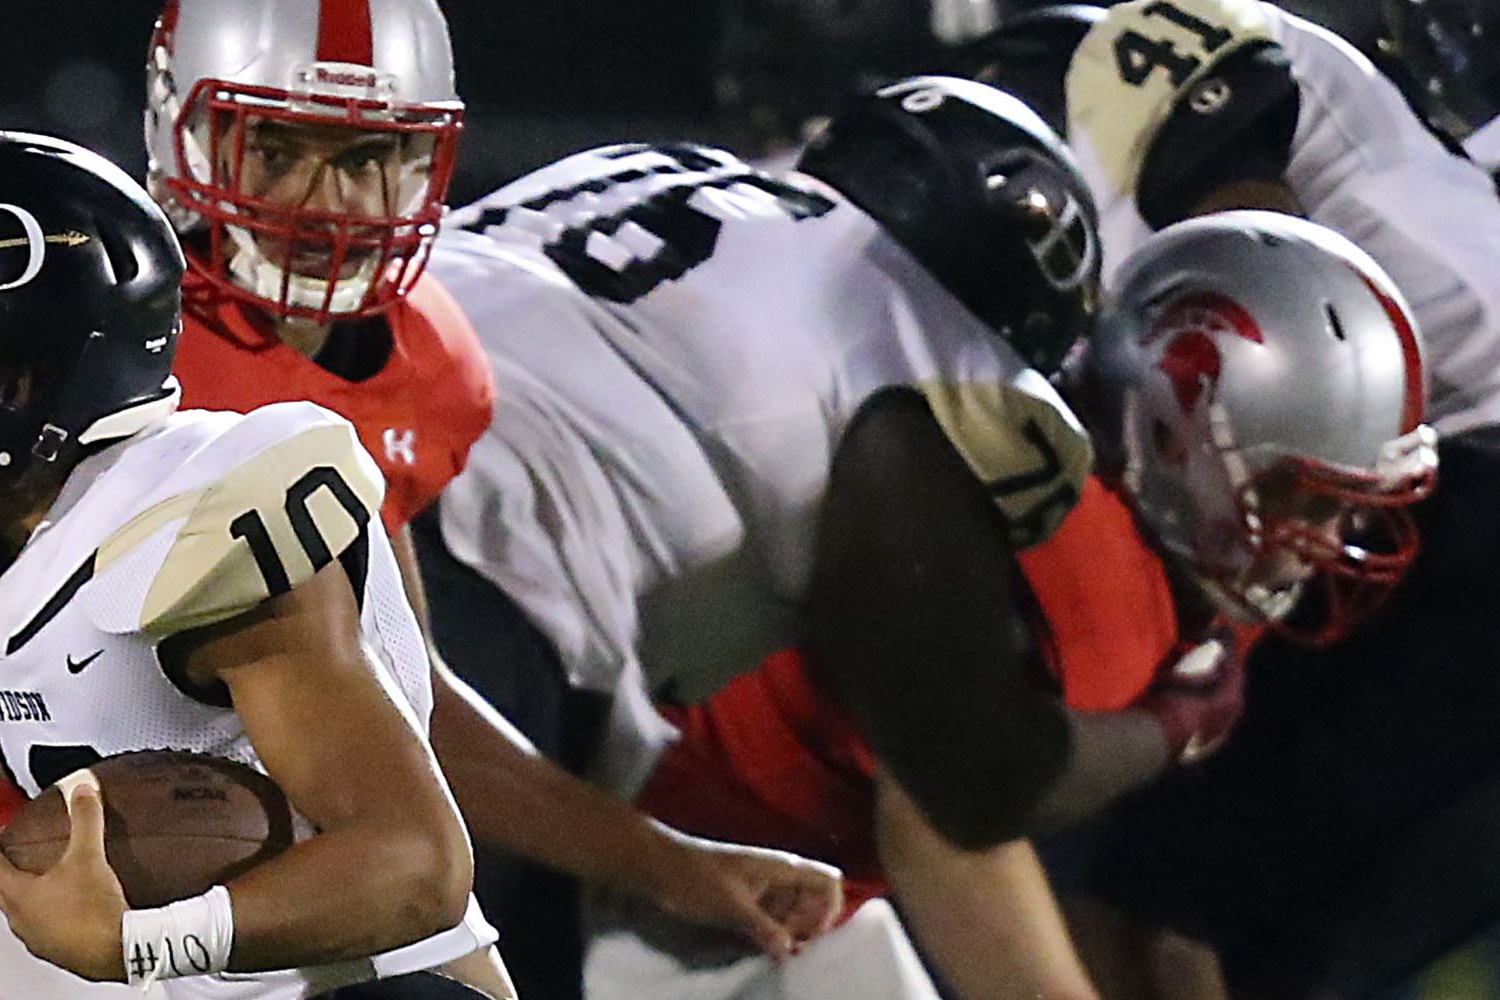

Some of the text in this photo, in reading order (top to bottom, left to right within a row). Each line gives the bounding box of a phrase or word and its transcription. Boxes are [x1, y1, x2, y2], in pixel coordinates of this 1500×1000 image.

[1115, 2, 1233, 87] 41
[229, 466, 370, 598] 10
[130, 934, 211, 978] #10
